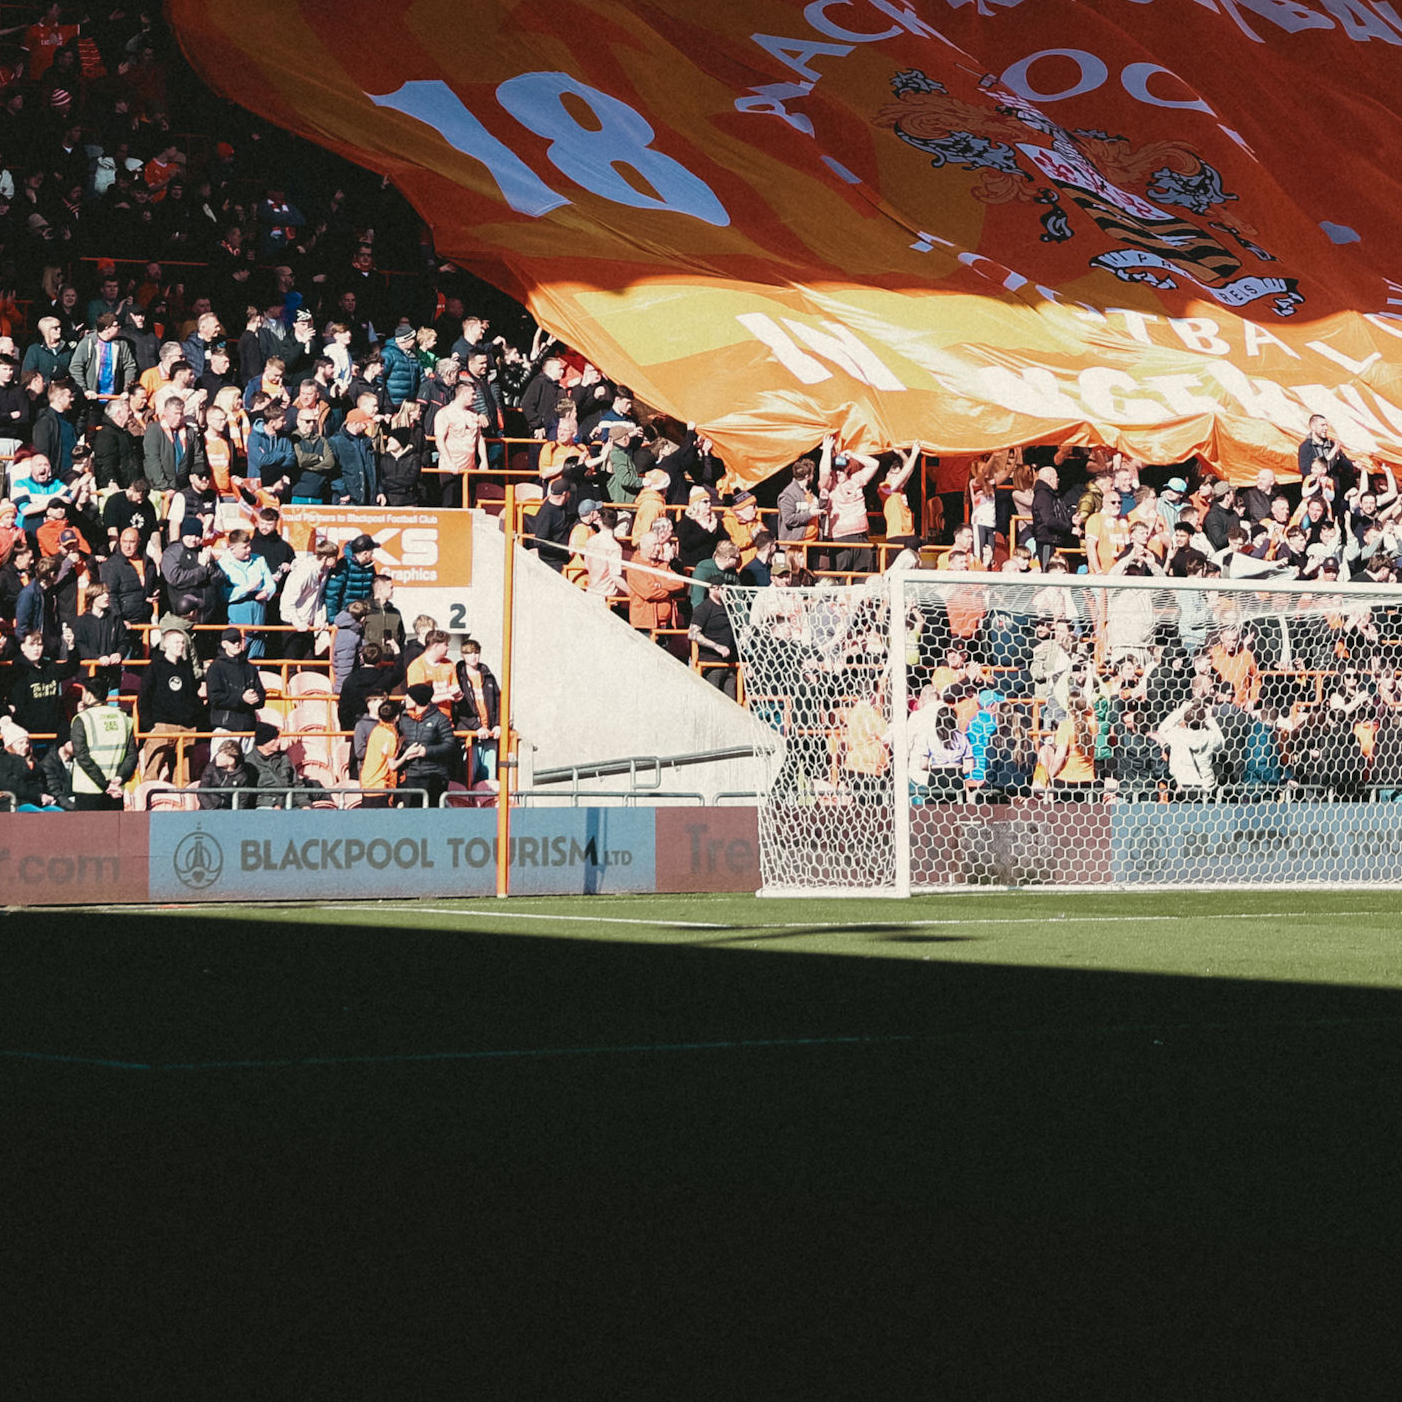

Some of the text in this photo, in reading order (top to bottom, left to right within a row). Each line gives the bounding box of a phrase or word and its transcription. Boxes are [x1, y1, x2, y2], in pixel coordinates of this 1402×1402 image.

[364, 71, 731, 226] 18
[303, 513, 336, 523] Partners
[337, 514, 345, 523] to
[347, 513, 385, 524] Blackpool
[386, 514, 418, 524] Football
[419, 514, 438, 524] Club
[381, 567, 438, 583] Graphics
[450, 603, 467, 629] 2
[240, 835, 632, 871] BLACKPOOL TOURISM LTD
